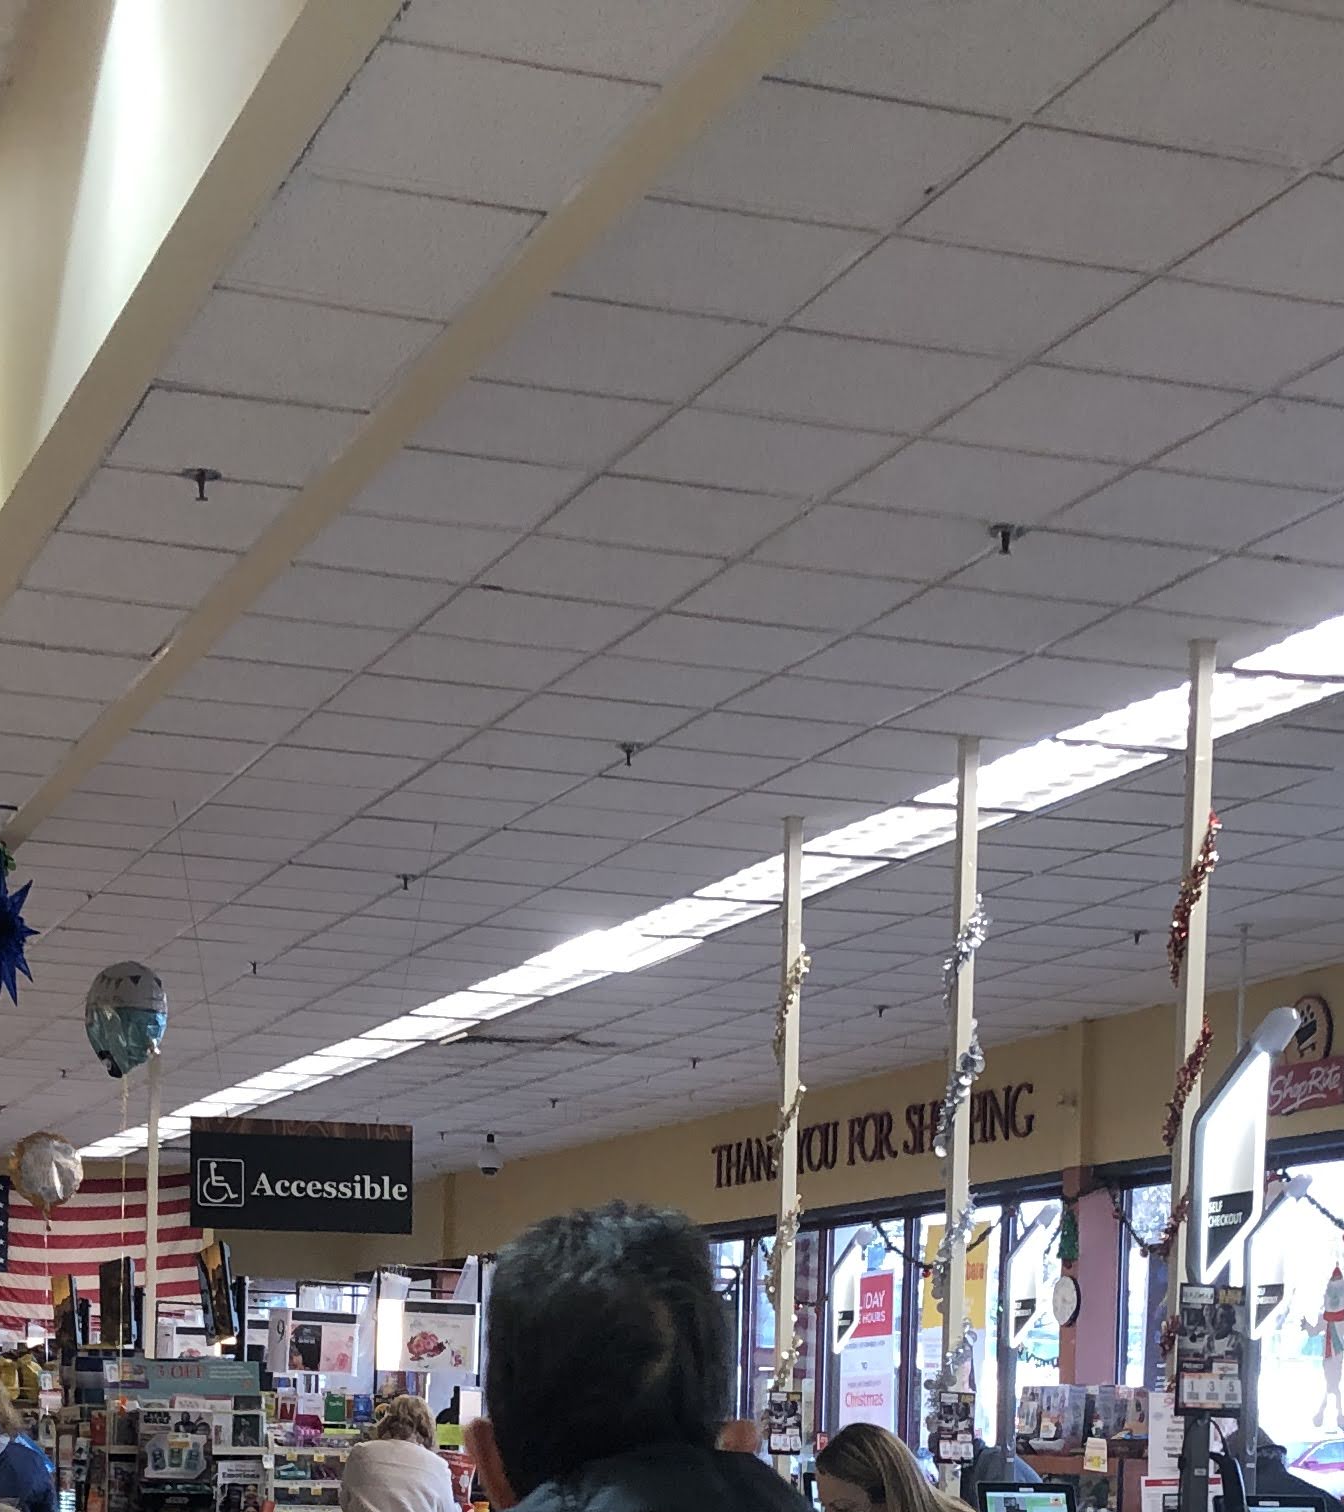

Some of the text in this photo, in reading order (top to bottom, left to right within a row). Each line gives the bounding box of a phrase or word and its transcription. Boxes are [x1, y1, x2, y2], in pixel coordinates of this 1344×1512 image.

[1268, 1064, 1342, 1114] ShopRite
[712, 1136, 780, 1188] THAN
[847, 1111, 898, 1166] FOR
[251, 1172, 408, 1201] Accessible
[1208, 1200, 1223, 1213] SELF
[1208, 1212, 1242, 1228] CHECKOUT
